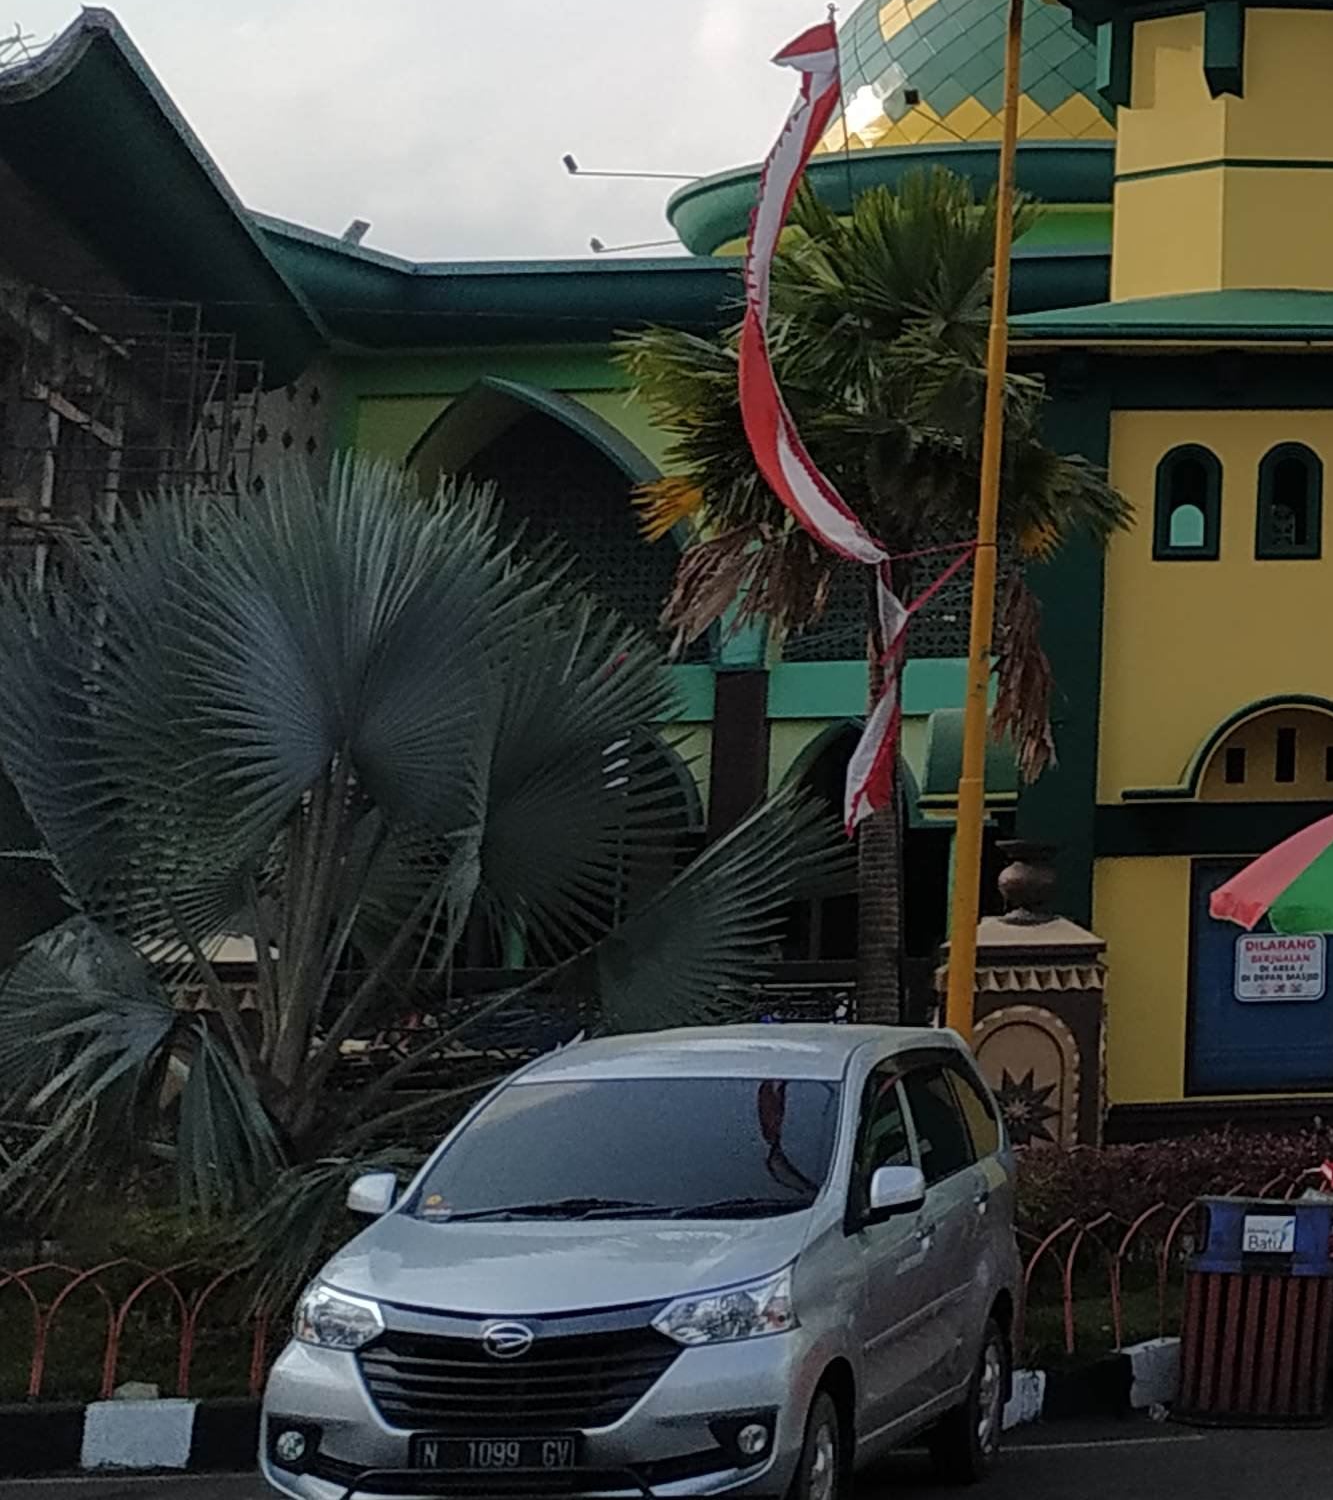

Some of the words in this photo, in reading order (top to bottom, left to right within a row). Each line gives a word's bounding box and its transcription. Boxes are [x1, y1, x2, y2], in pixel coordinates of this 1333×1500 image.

[1245, 939, 1317, 952] DILARANG
[1248, 1235, 1283, 1251] Batu
[424, 1441, 439, 1468] N
[467, 1441, 521, 1468] 1099
